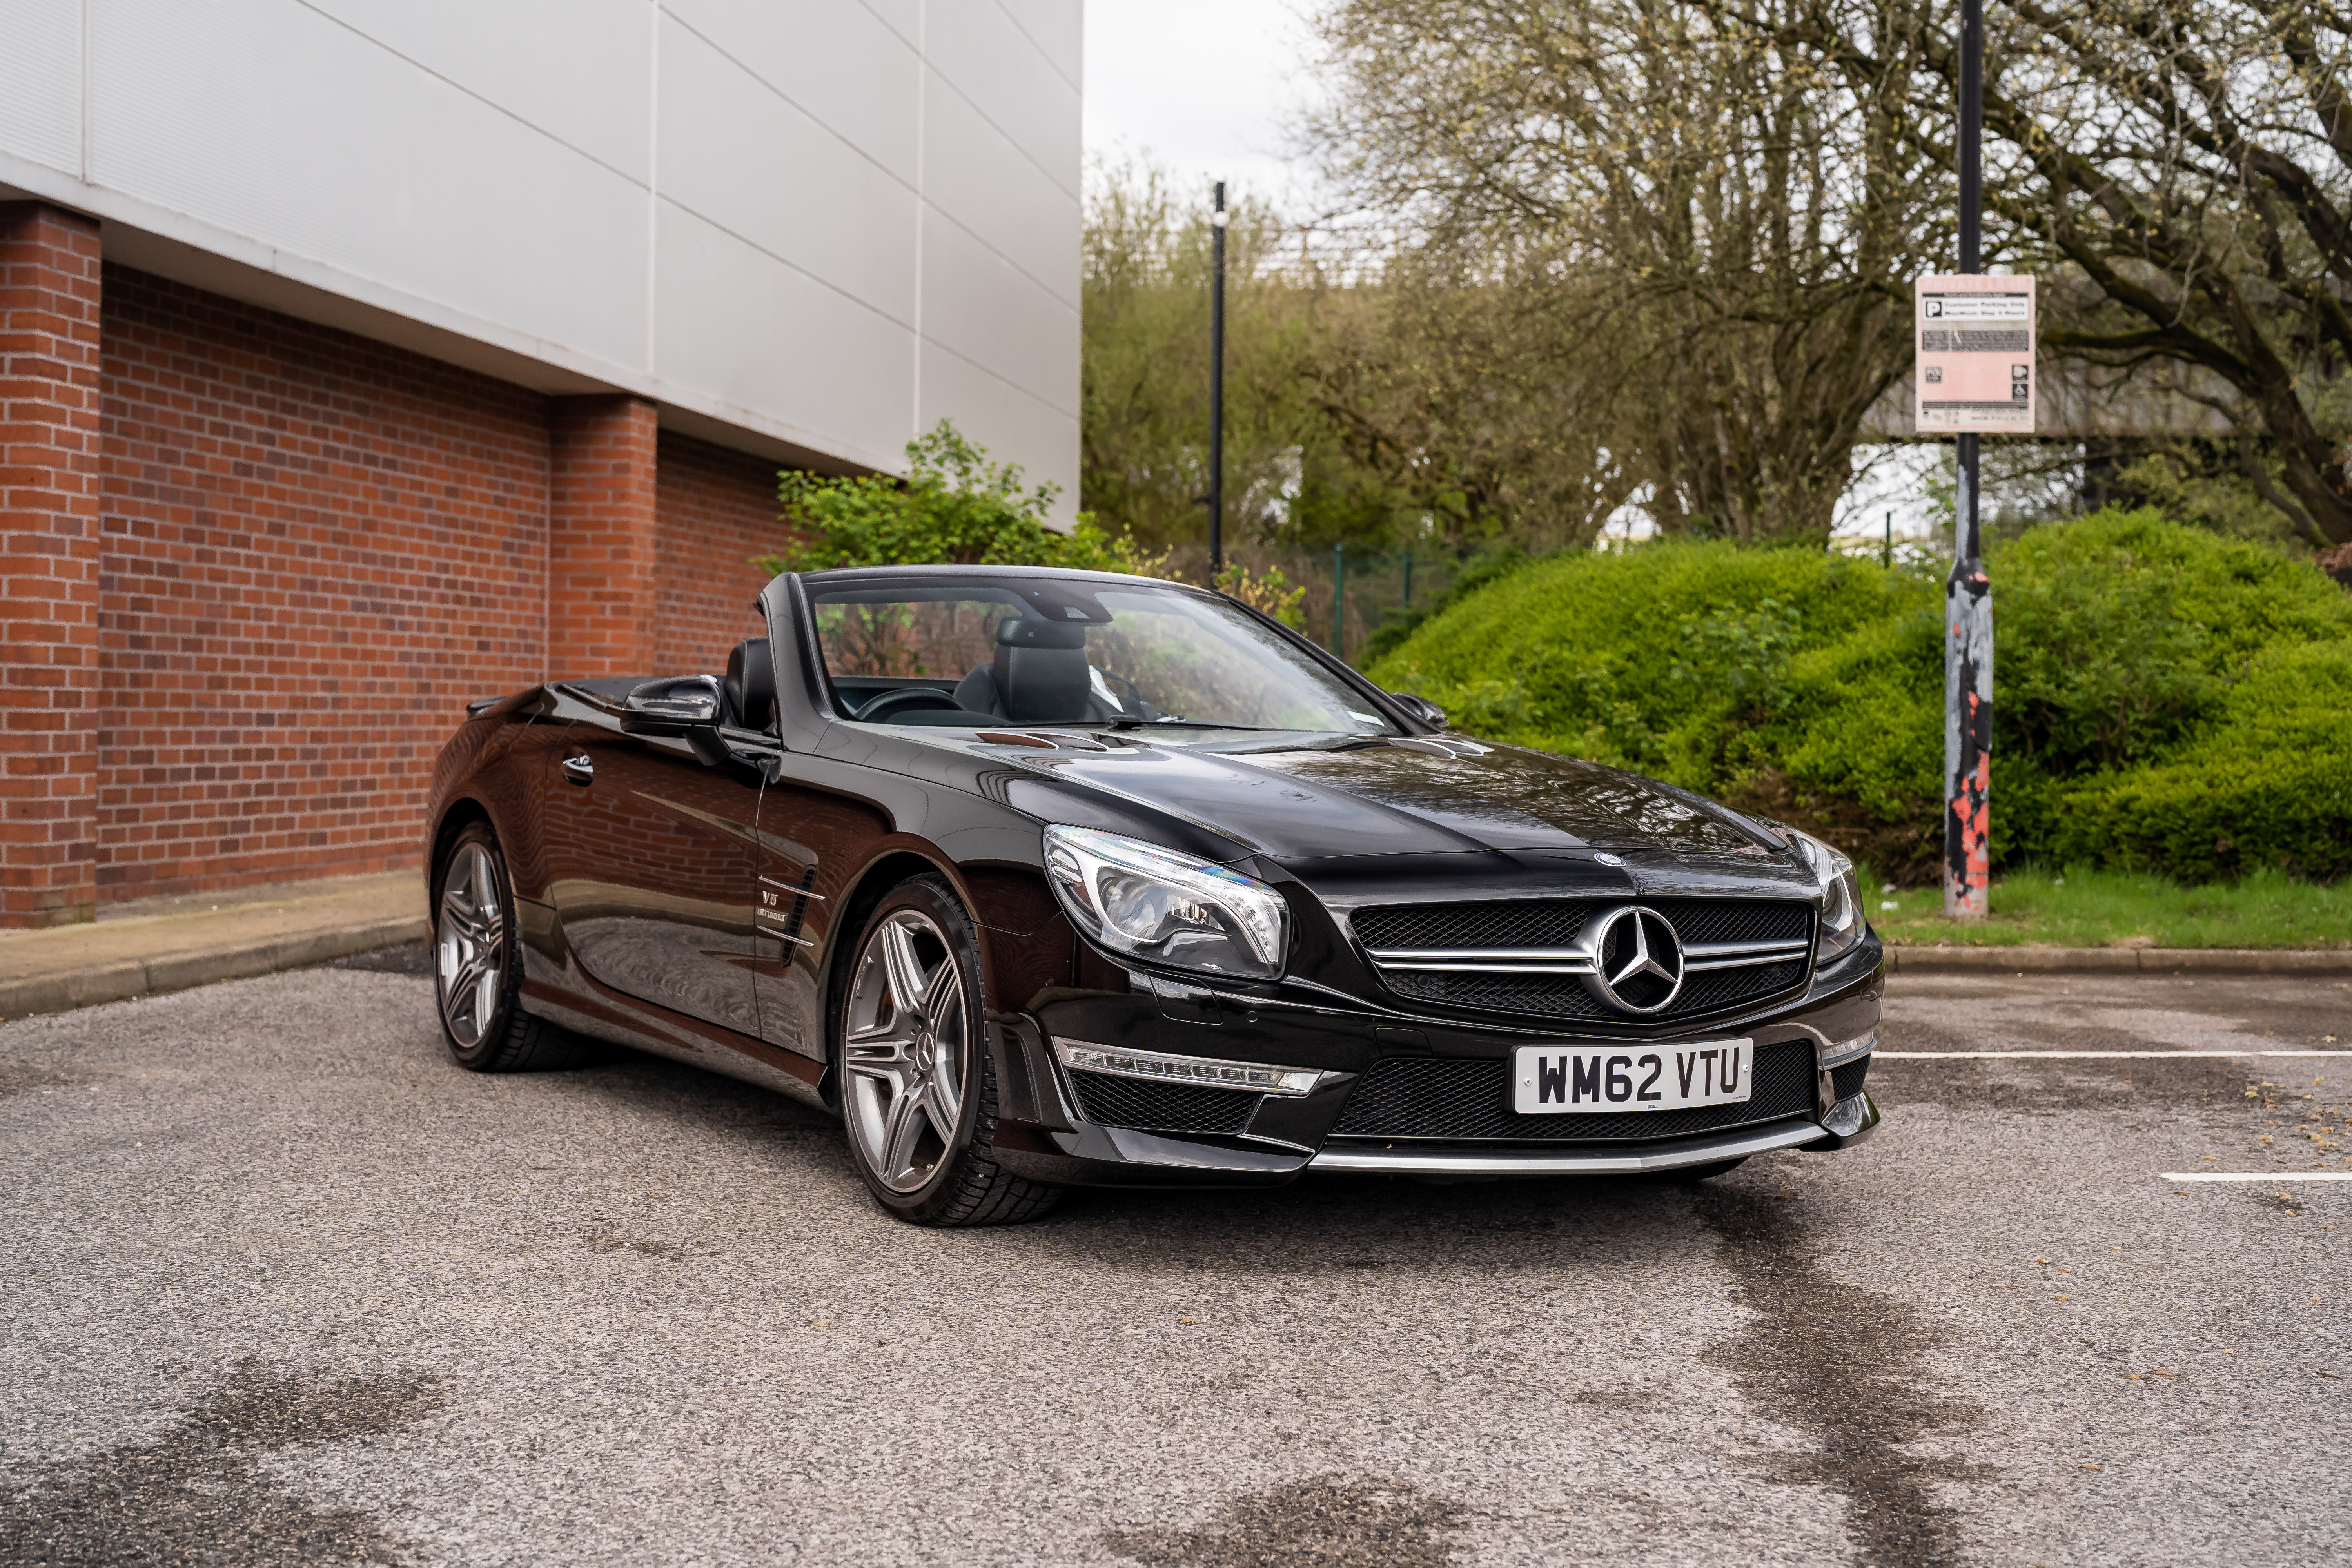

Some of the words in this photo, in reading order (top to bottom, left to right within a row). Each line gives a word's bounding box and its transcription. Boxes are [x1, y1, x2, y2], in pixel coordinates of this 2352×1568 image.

[1925, 279, 1979, 289] PRIVATE
[1988, 279, 2025, 289] LAND
[762, 891, 778, 906] V8
[1539, 1054, 1662, 1103] WM62
[1676, 1047, 1739, 1098] VTU
